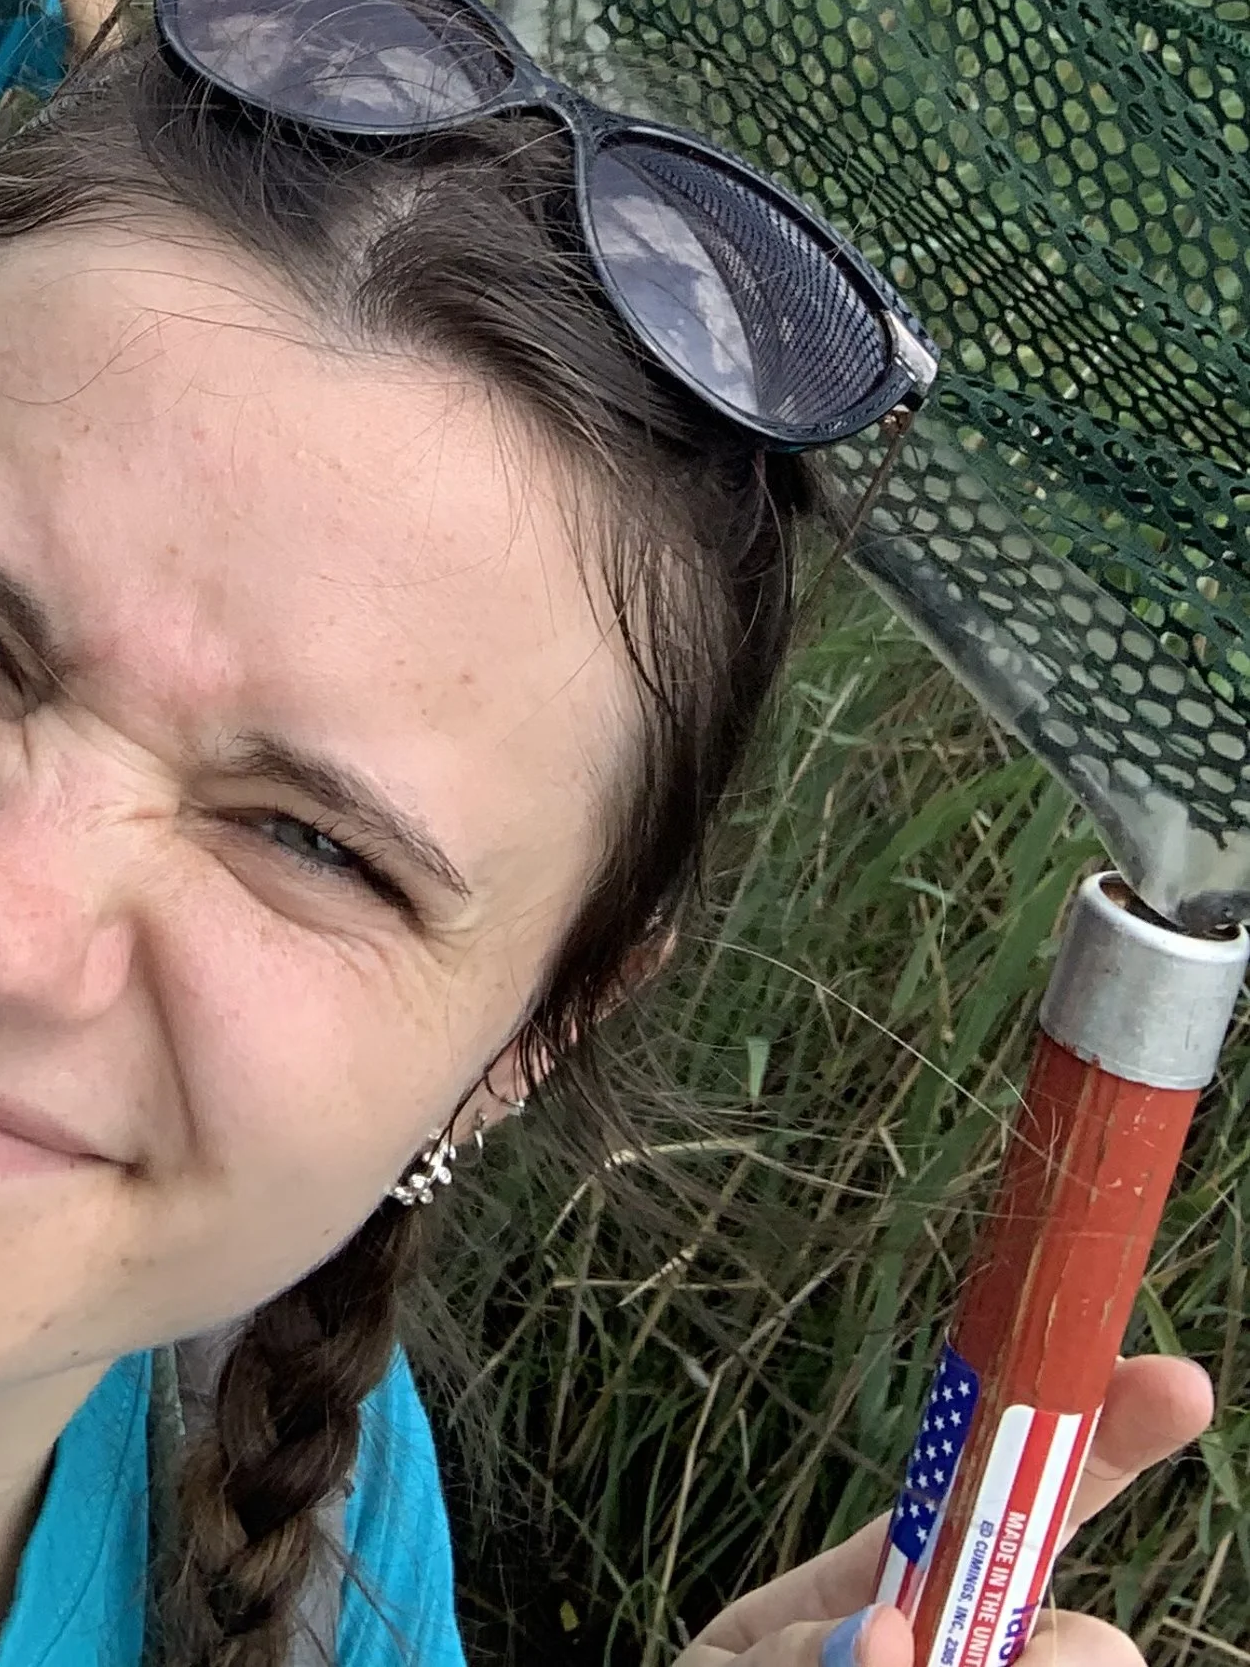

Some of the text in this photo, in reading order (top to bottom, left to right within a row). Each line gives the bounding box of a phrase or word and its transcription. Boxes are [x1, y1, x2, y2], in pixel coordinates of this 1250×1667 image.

[979, 1520, 995, 1538] ED
[998, 1510, 1026, 1565] MADE
[957, 1540, 989, 1601] CUMINGS,
[988, 1566, 1010, 1588] IN
[976, 1590, 1004, 1624] THE
